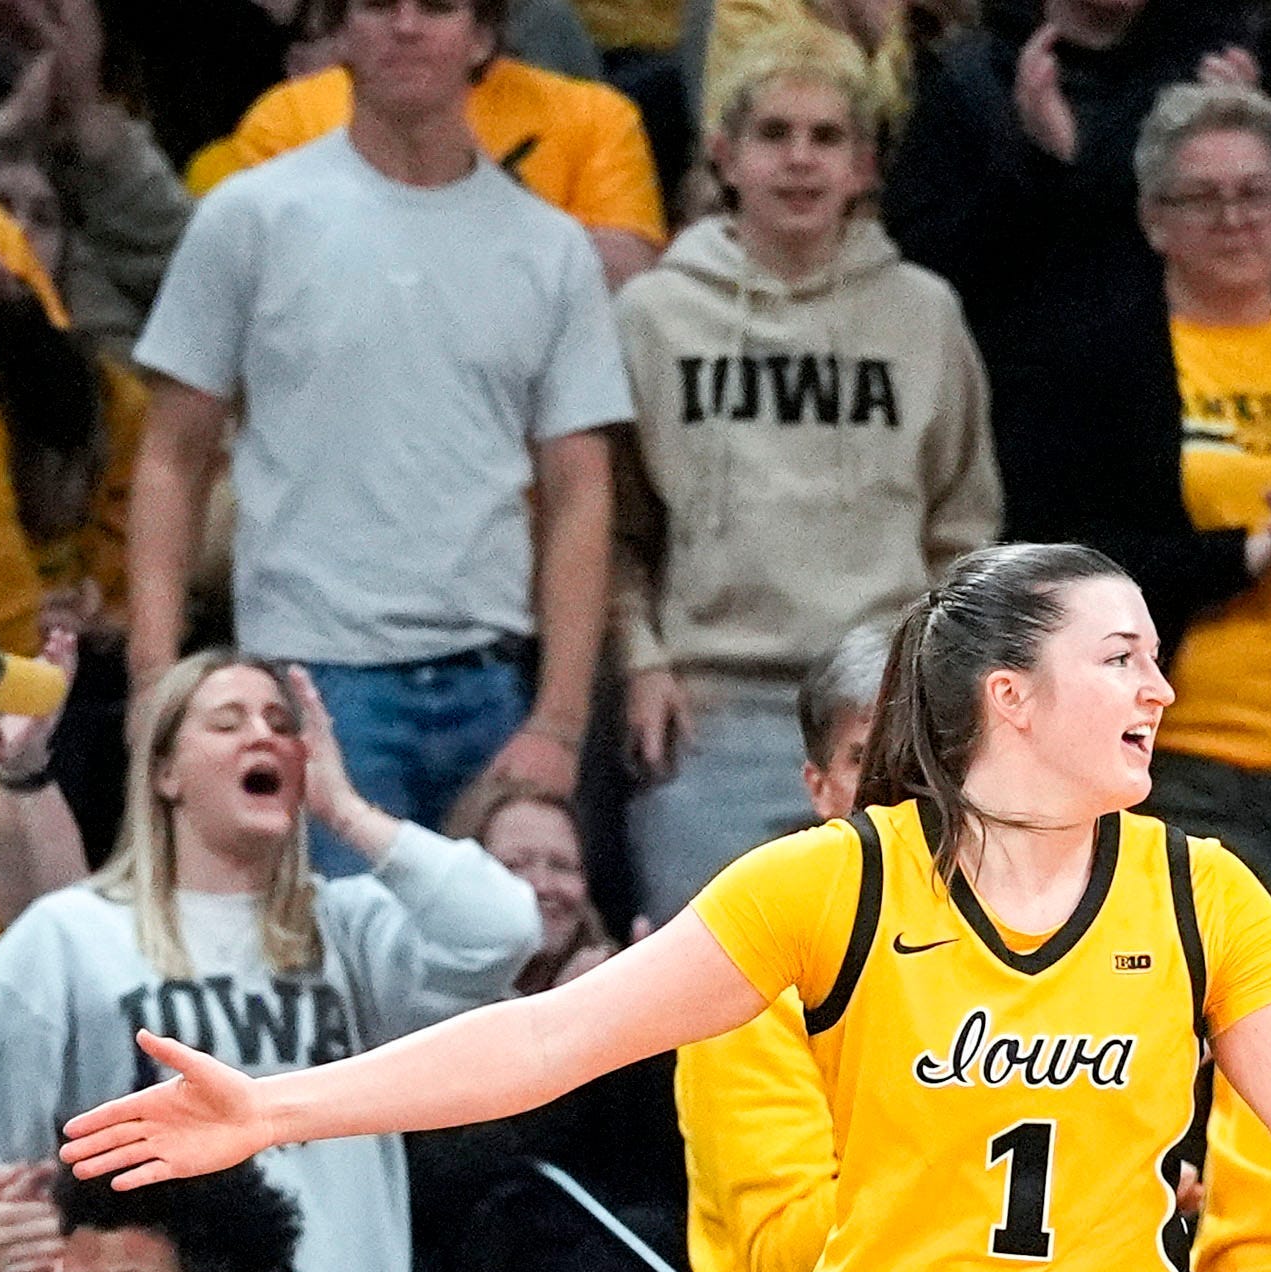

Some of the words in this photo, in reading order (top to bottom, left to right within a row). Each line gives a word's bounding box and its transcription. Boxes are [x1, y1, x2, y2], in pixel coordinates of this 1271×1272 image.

[680, 355, 899, 427] IOWA
[915, 1008, 1136, 1088] Iowa
[987, 1119, 1056, 1262] 1
